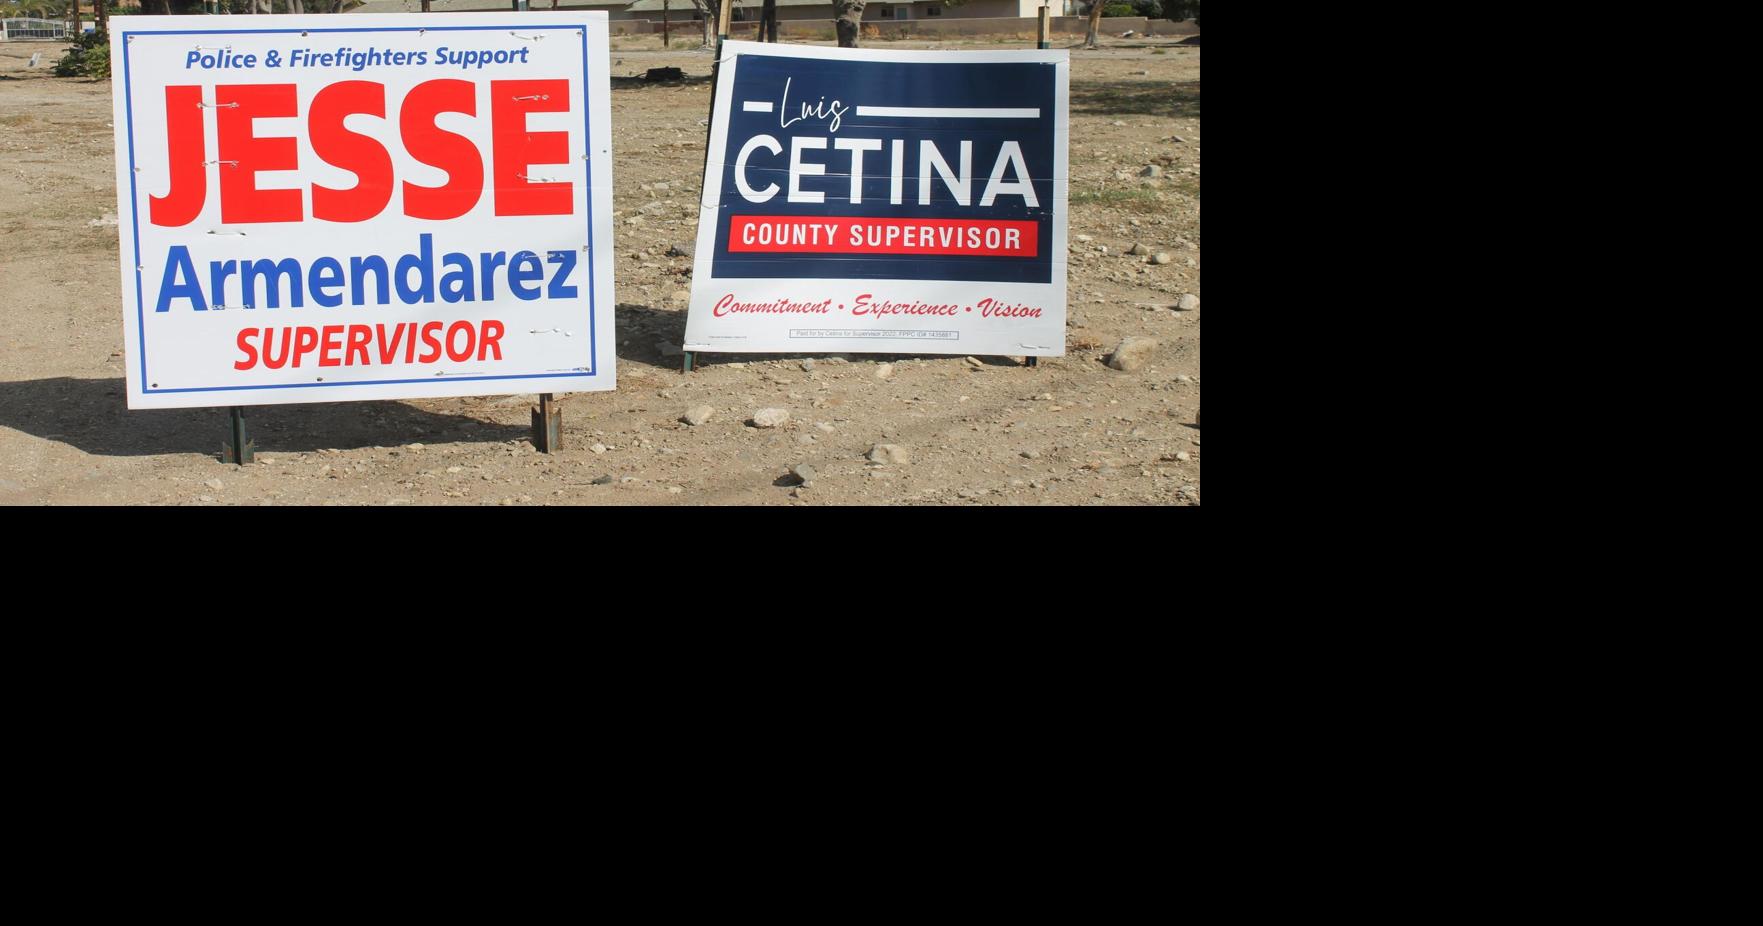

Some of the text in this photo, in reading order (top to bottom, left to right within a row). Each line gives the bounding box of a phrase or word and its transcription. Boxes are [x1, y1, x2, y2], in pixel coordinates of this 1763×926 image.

[186, 47, 529, 72] Police & Firefighters Support
[780, 77, 849, 133] Luis
[149, 78, 574, 228] JESSE
[734, 134, 1040, 208] CETINA
[742, 222, 1021, 249] COUNTY SUPERVISOR
[155, 233, 579, 313] Armendarez
[712, 294, 1042, 318] Commitment Experience Vision
[234, 320, 504, 371] SUPERVISOR
